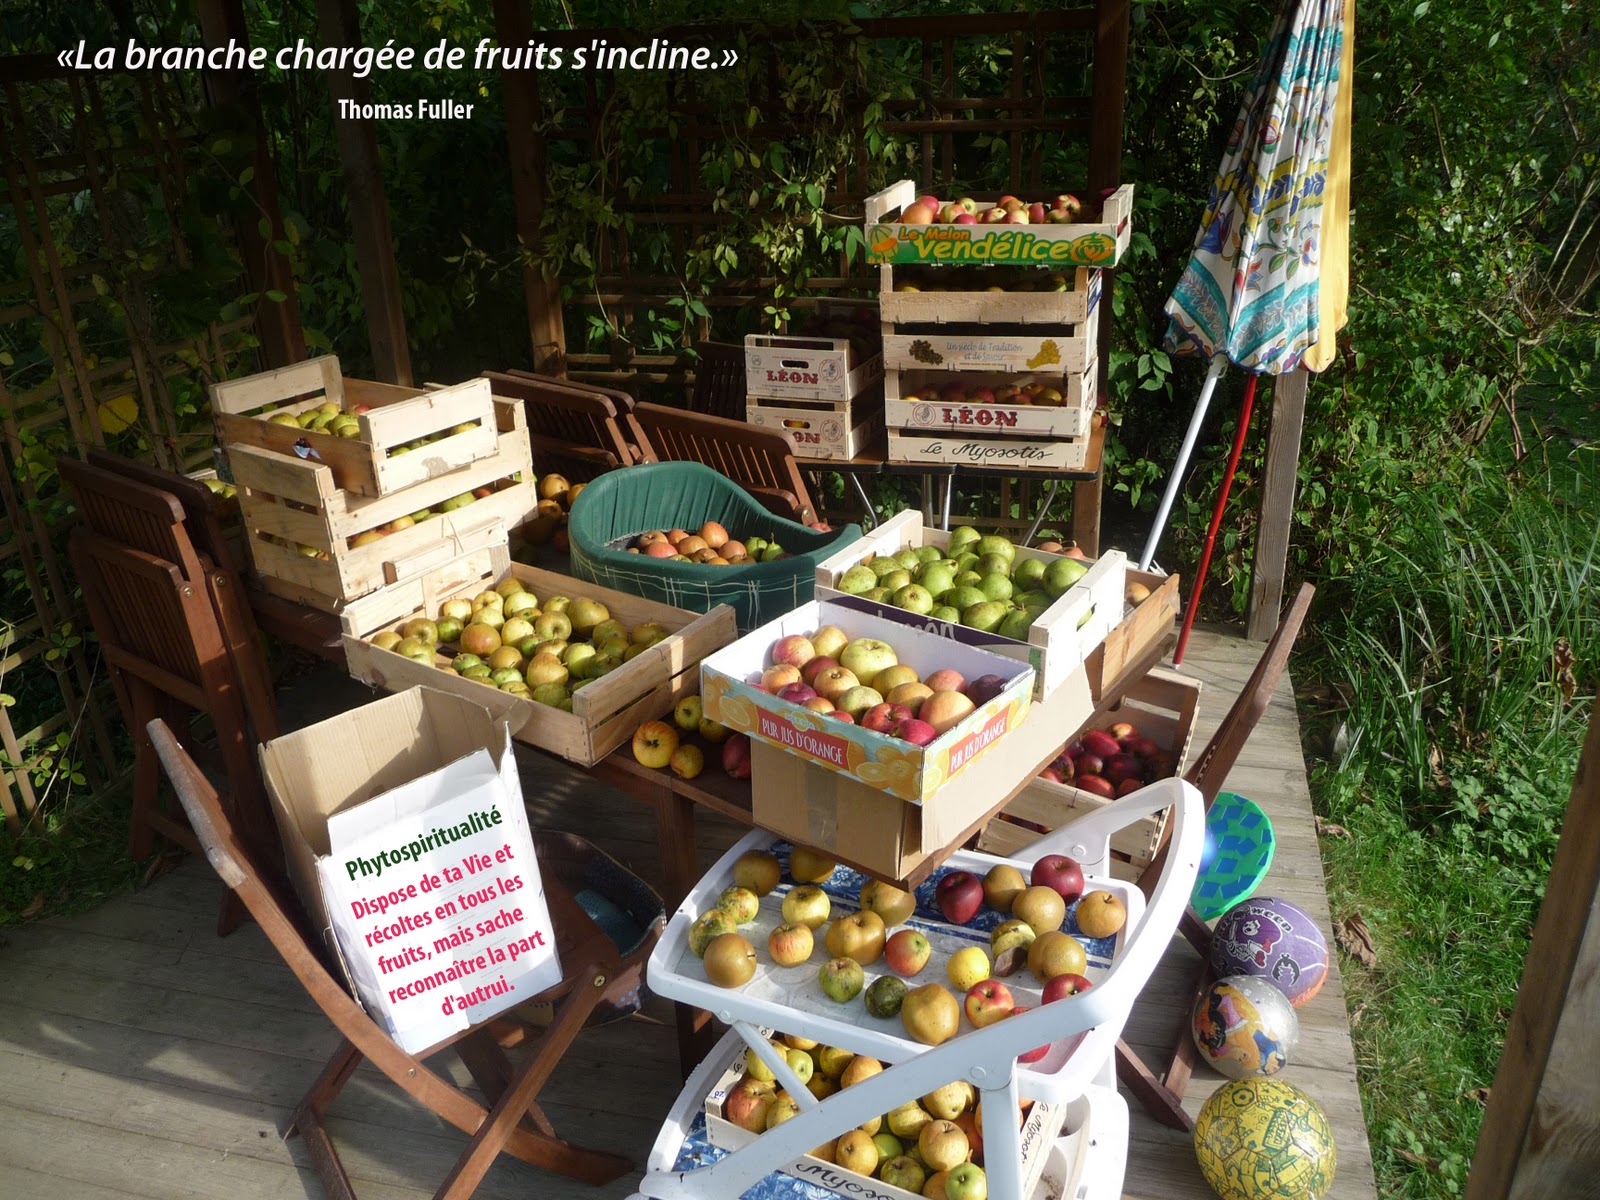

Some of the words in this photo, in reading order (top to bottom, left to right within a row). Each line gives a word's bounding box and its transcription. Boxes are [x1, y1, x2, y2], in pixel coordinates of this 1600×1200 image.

[900, 226, 919, 241] Le
[925, 226, 970, 241] Melon
[766, 369, 819, 385] LÉON
[942, 406, 1018, 427] LÉON
[792, 431, 821, 444] ON
[920, 441, 942, 454] Le
[952, 443, 1053, 461] Myosotis
[762, 718, 779, 739] PUR
[780, 726, 795, 746] JUS
[795, 732, 843, 764] D'ORANGE
[950, 750, 963, 772] PUR
